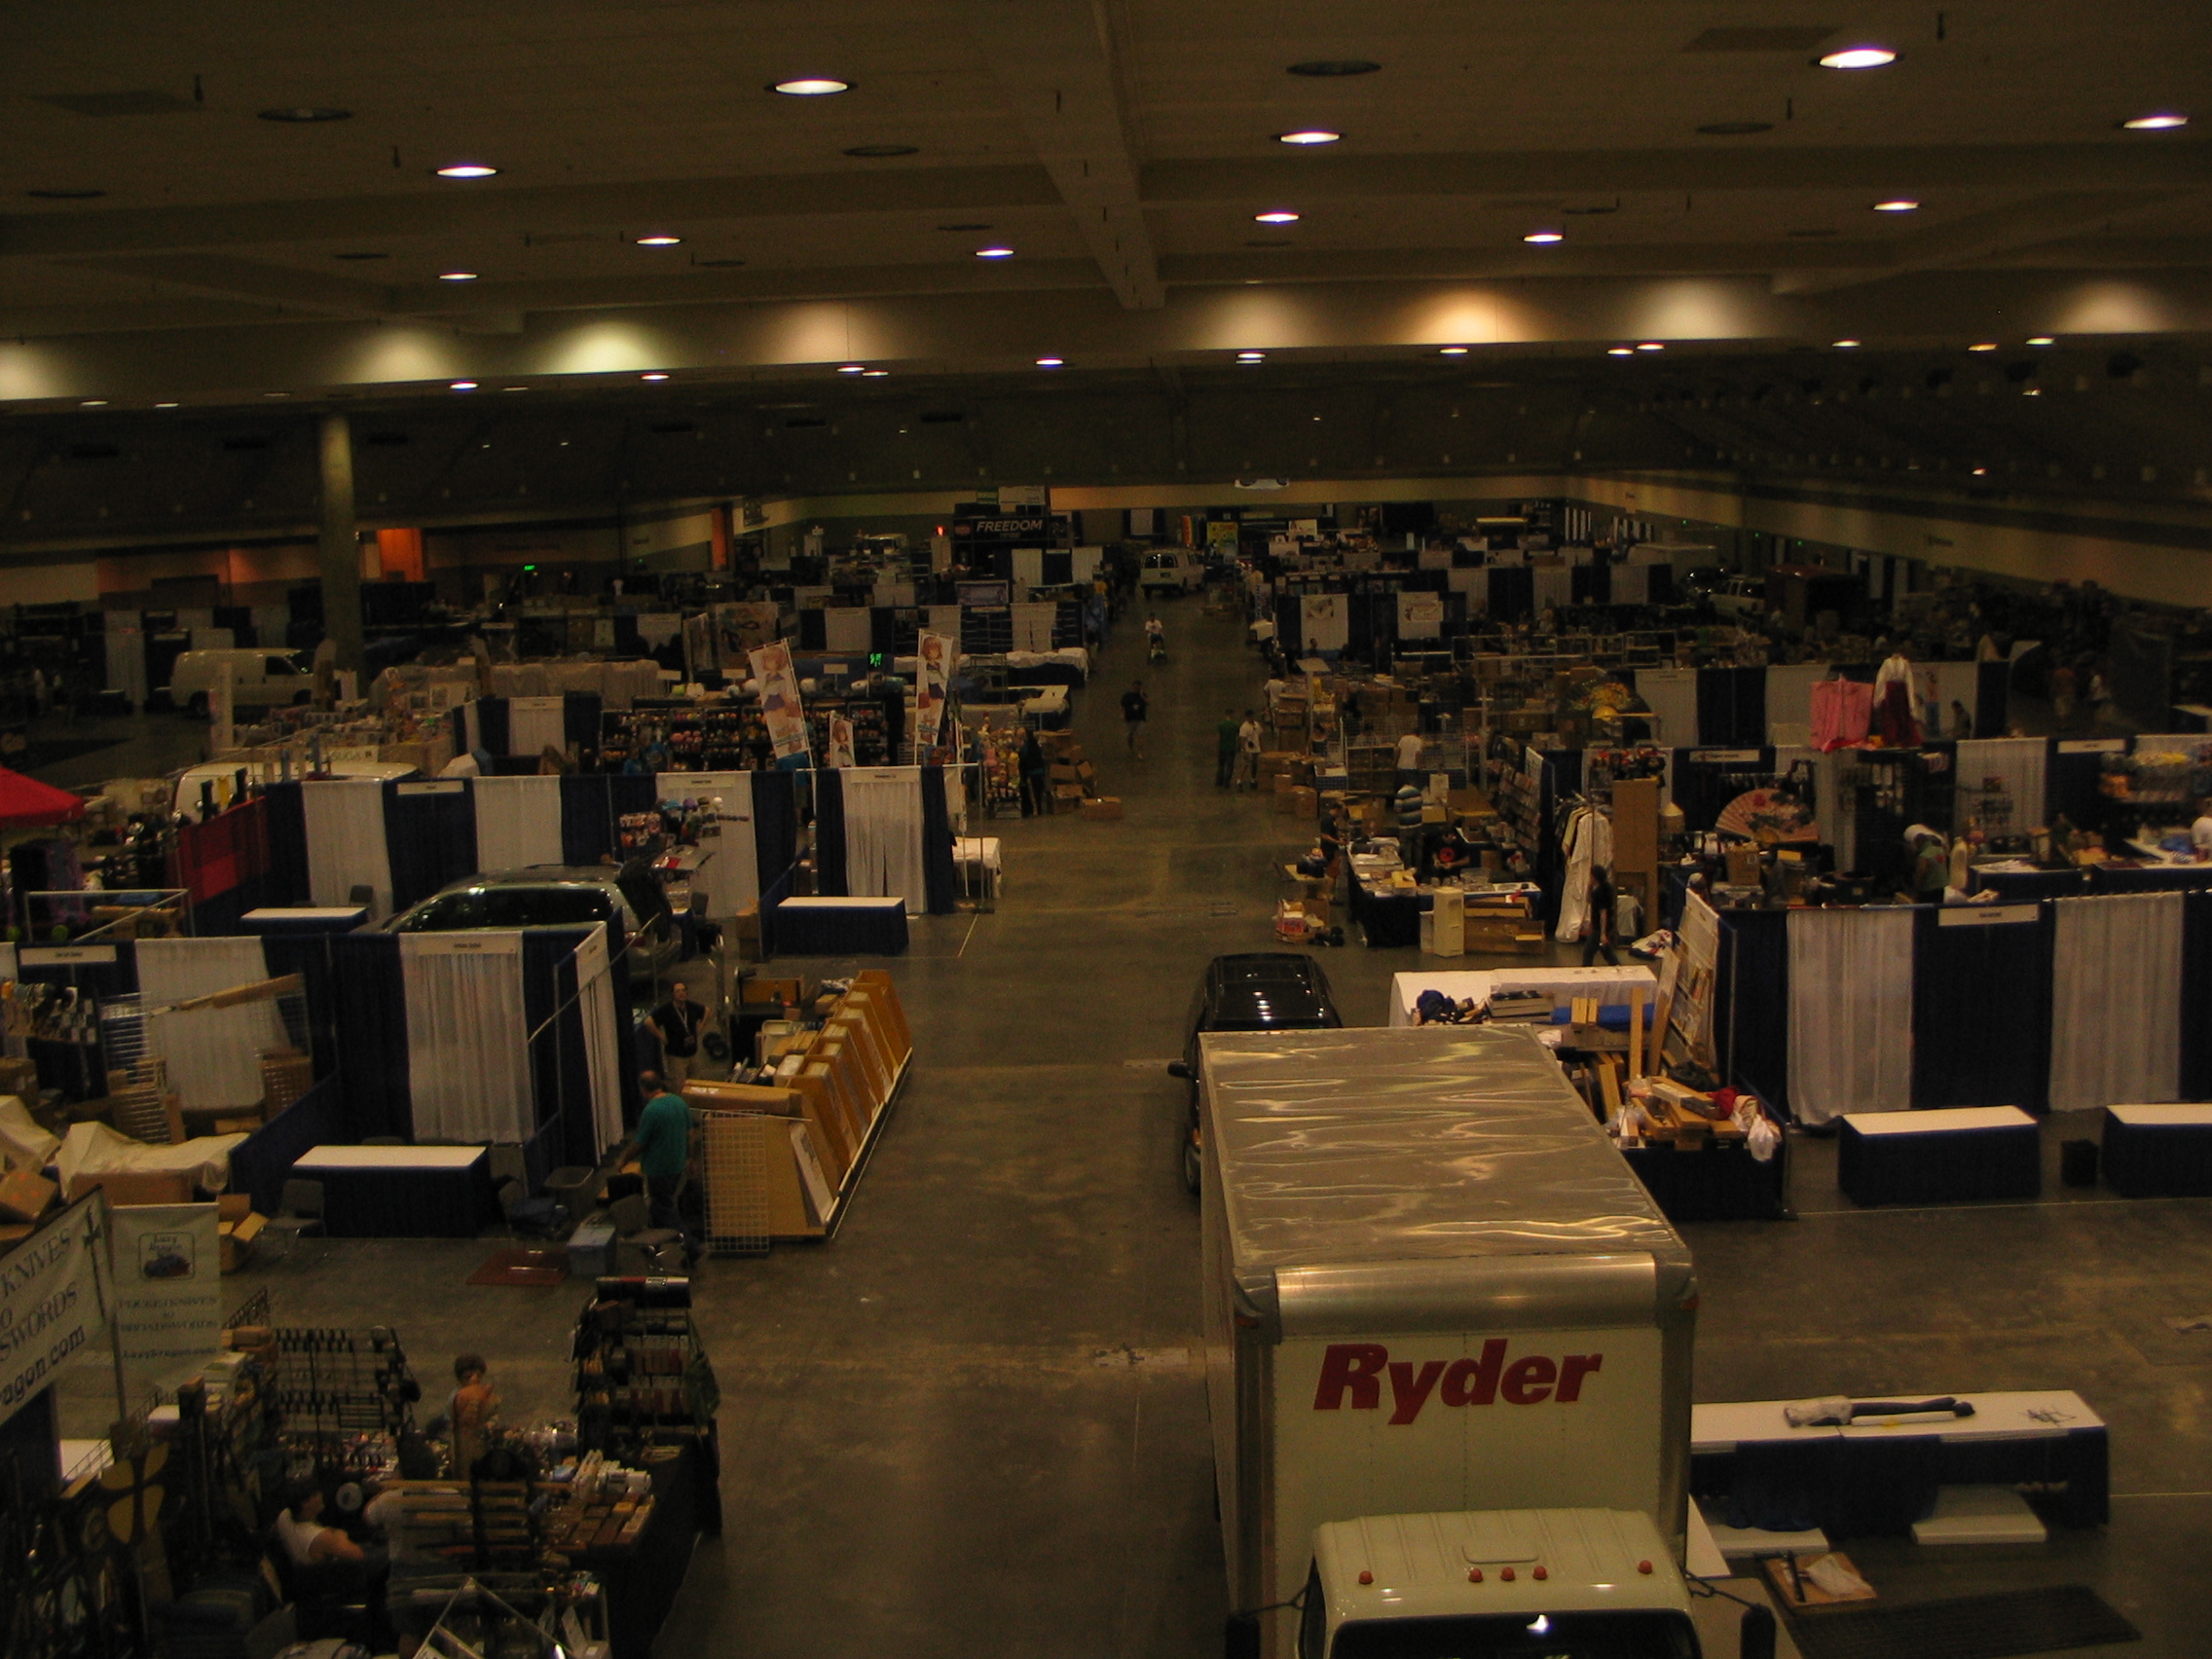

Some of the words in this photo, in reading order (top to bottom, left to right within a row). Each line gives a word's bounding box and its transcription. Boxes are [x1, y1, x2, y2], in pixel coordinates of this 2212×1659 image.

[977, 519, 1043, 532] FREEDOM
[0, 1324, 86, 1406] agon.com
[1312, 1338, 1604, 1425] Ryder
